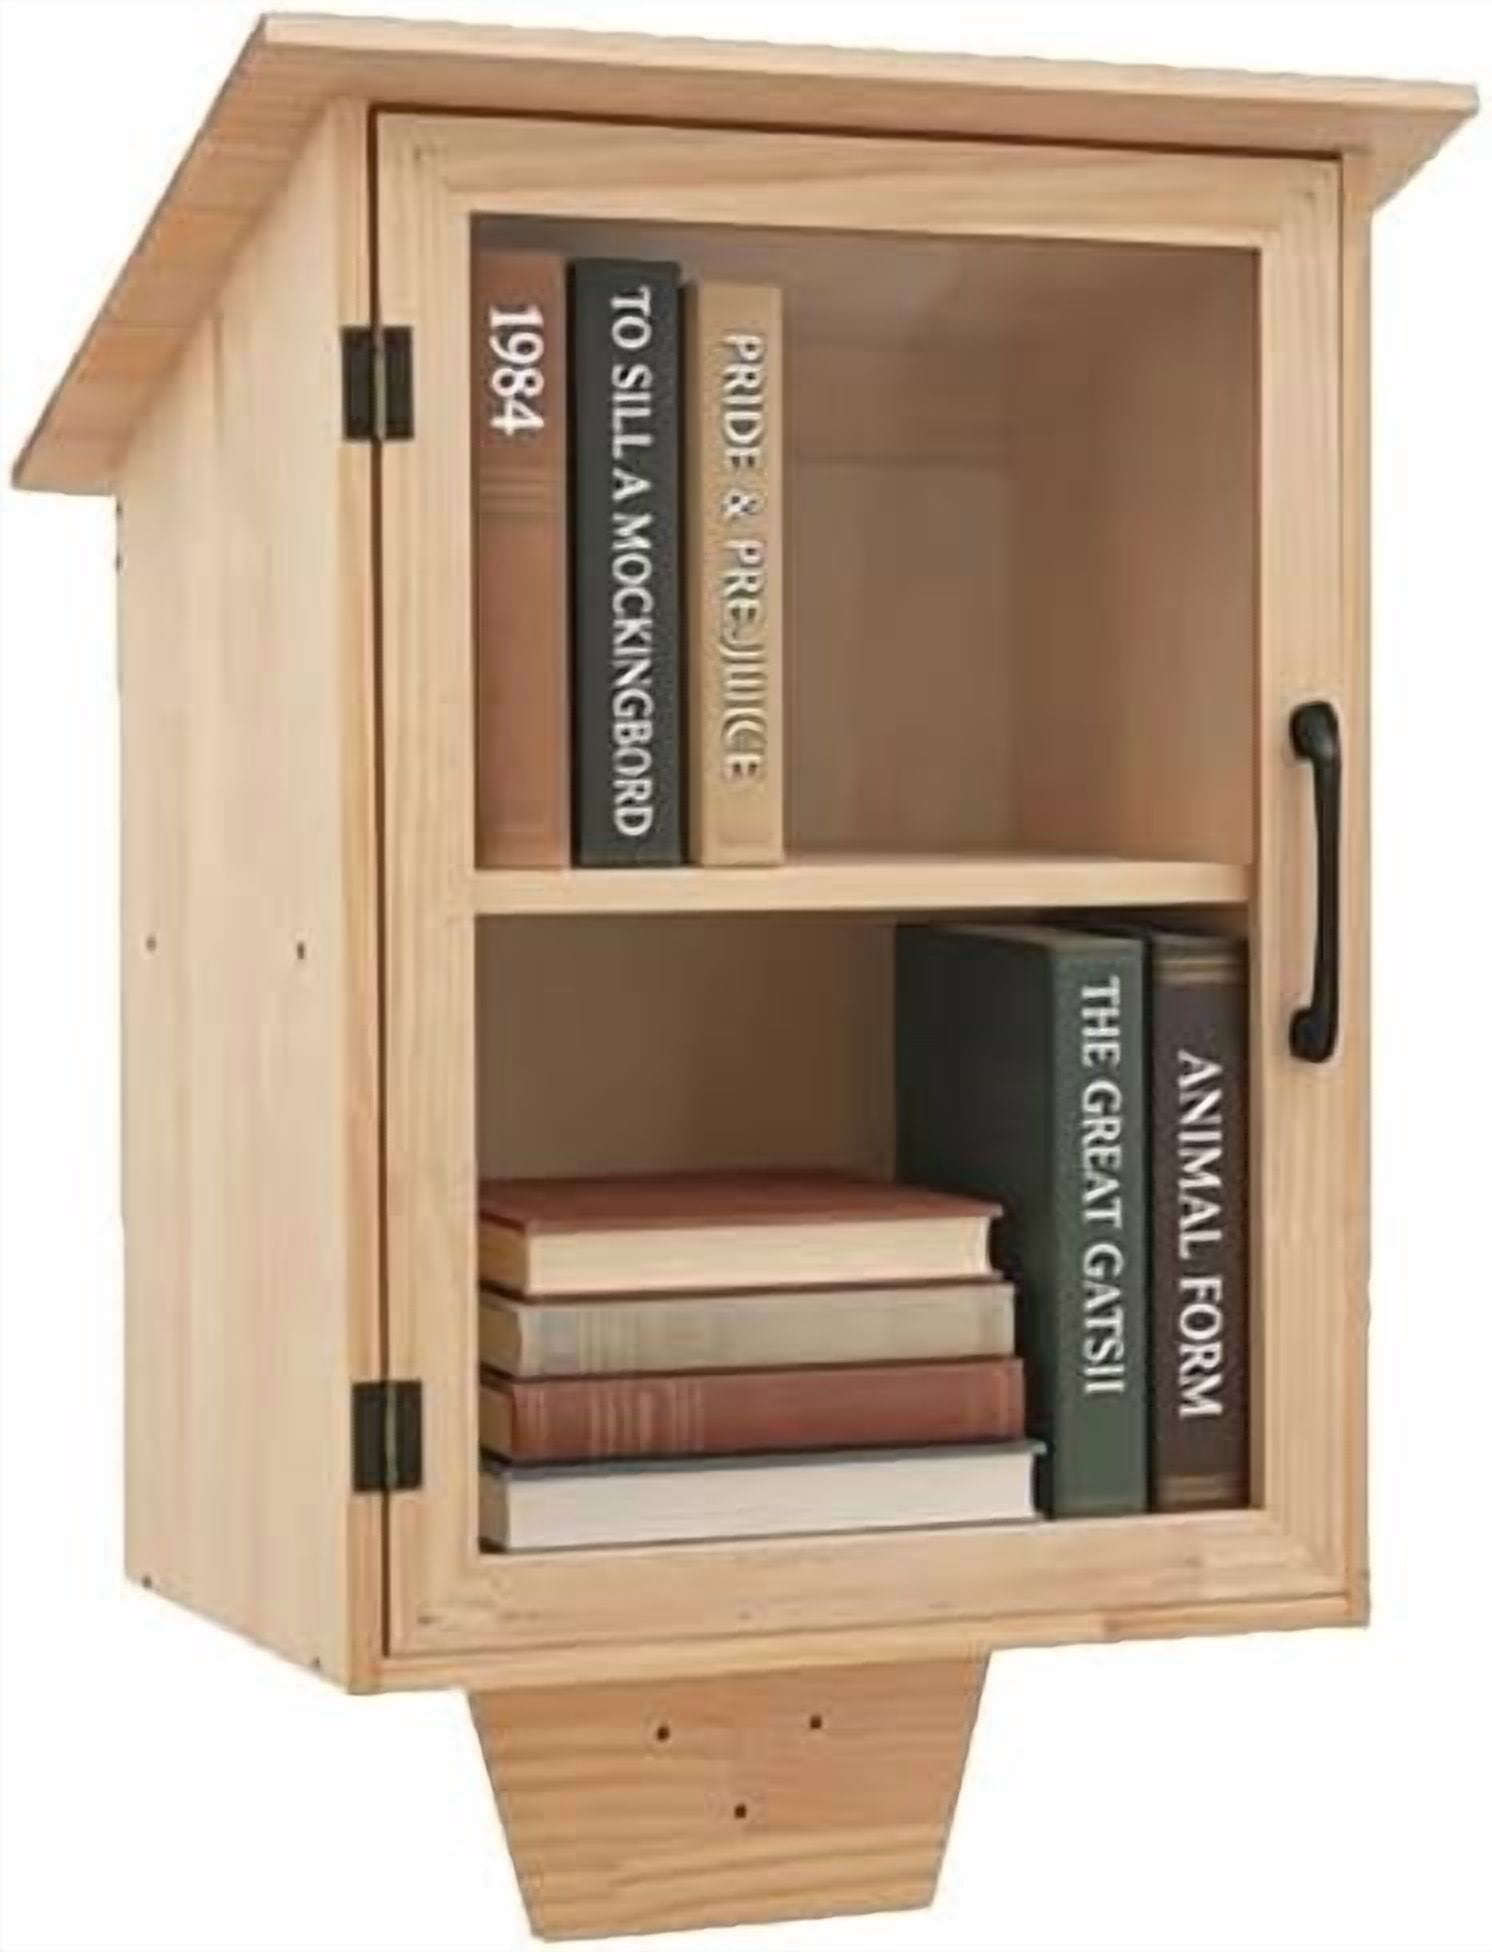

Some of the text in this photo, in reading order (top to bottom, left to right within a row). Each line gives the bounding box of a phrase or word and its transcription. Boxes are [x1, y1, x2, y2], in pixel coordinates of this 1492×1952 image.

[611, 286, 650, 350] TO
[489, 304, 546, 436] 1984
[611, 363, 653, 458] SILL
[722, 334, 766, 468] PRIDE
[612, 468, 652, 500] A
[722, 491, 765, 522] &
[1081, 976, 1121, 1066] THE
[1081, 1080, 1124, 1229] GREAT
[1176, 1050, 1223, 1418] ANIMAL FORM
